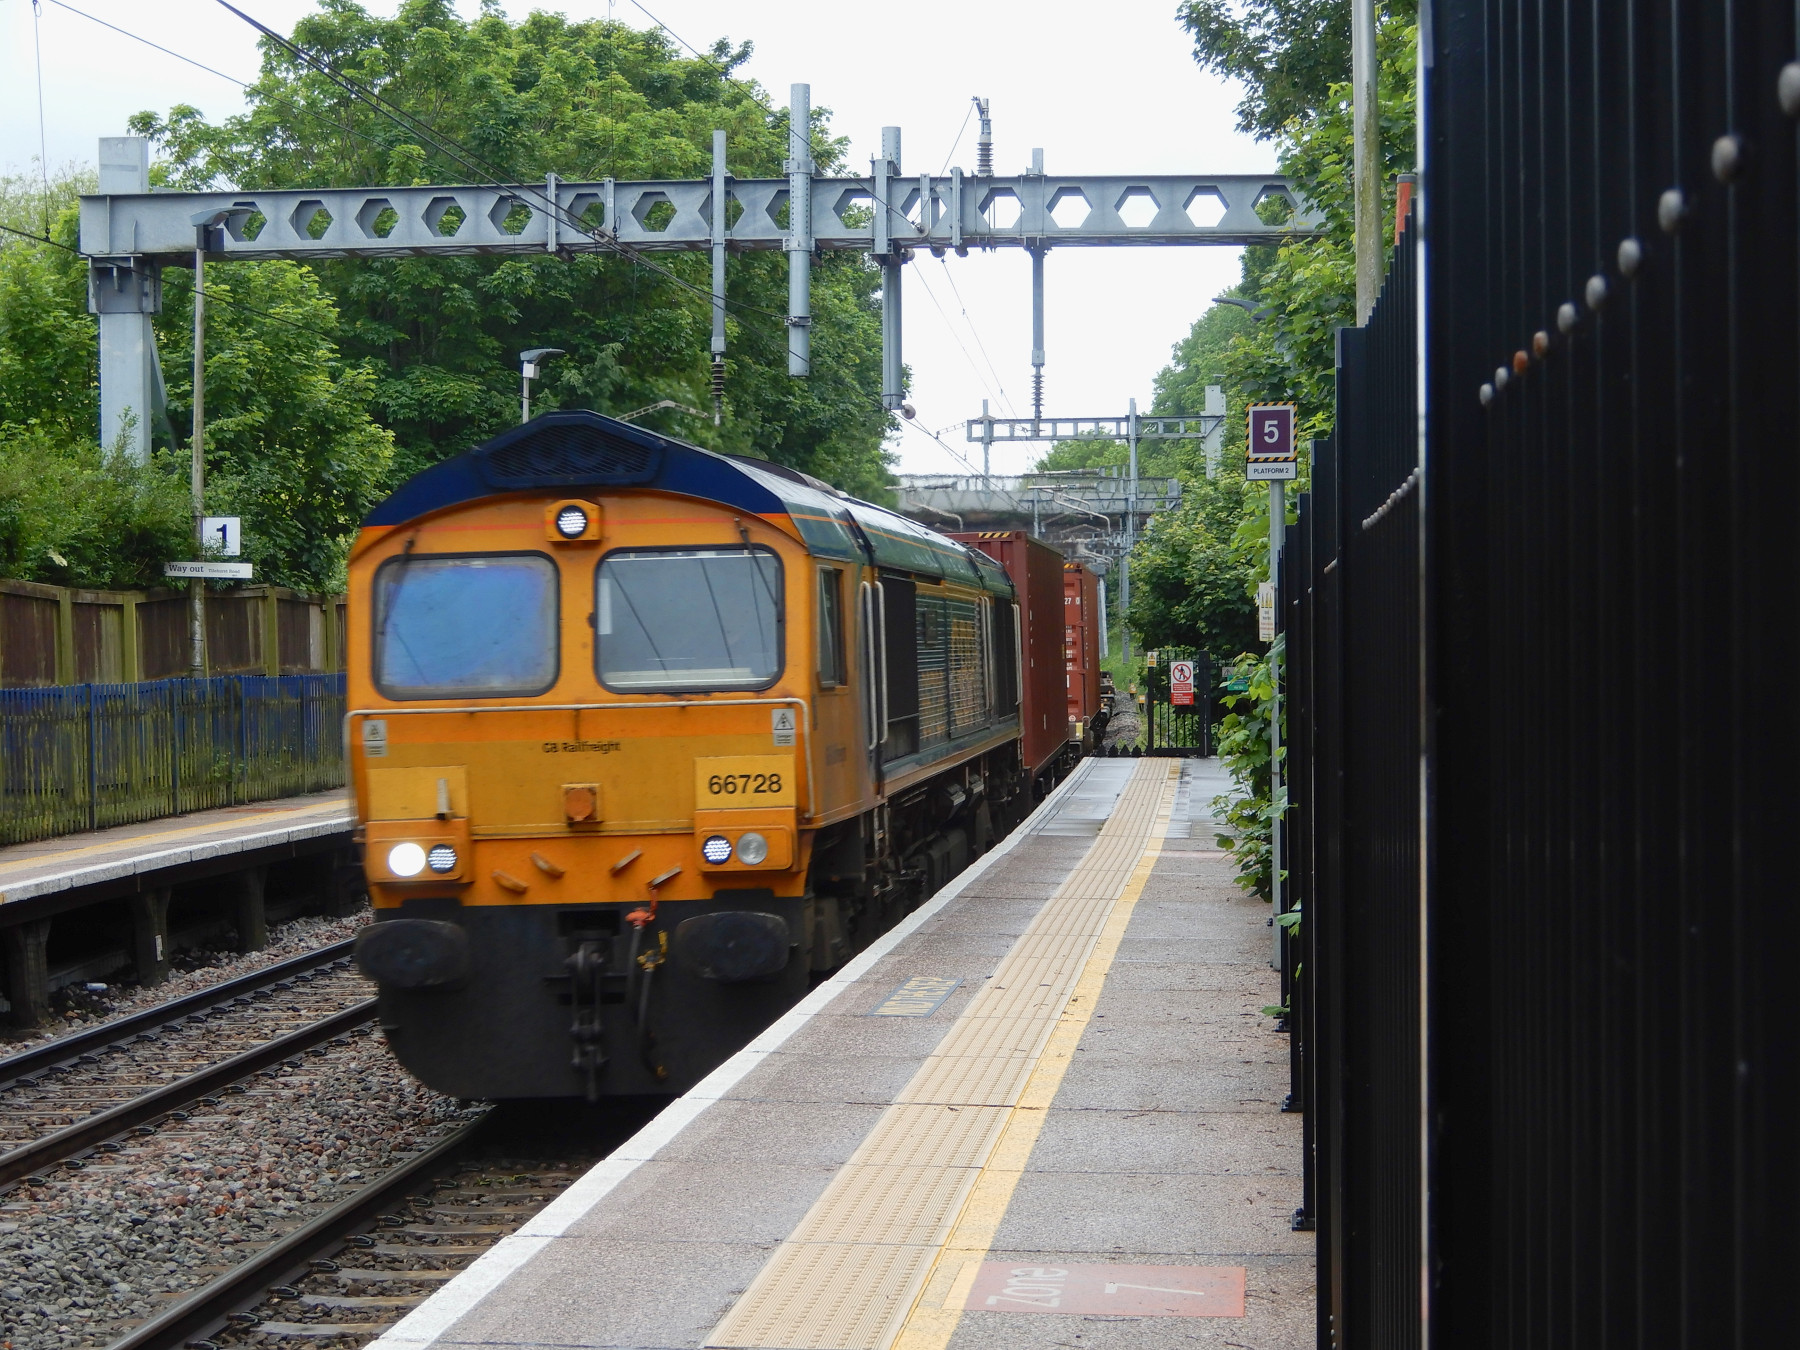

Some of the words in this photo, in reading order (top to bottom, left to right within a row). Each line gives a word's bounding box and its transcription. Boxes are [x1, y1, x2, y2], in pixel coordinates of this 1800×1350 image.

[1263, 420, 1279, 443] 5
[216, 523, 227, 549] 1
[169, 564, 187, 573] Way
[709, 773, 782, 795] 66728
[985, 1267, 1068, 1308] Zone
[1104, 1282, 1205, 1295] 7
